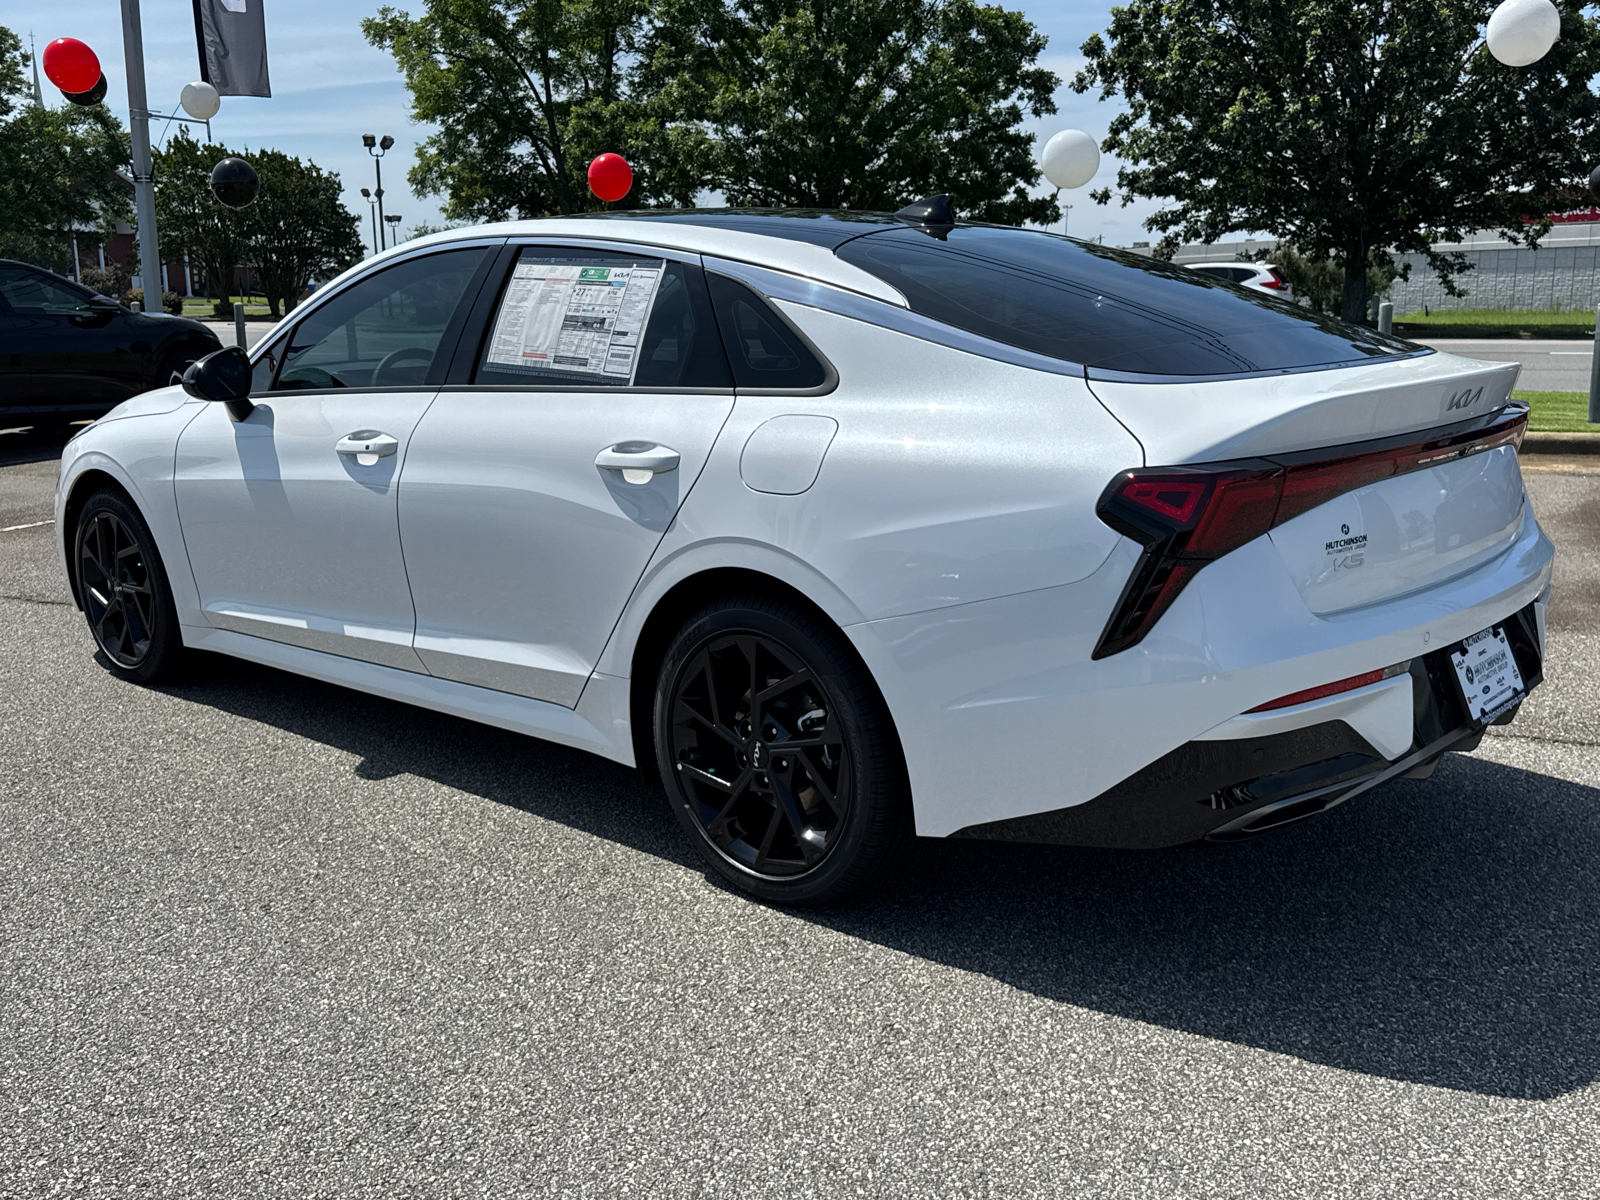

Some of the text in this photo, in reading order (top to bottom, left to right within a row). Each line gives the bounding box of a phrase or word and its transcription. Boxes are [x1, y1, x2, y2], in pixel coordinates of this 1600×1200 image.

[1446, 385, 1484, 411] KIA
[1325, 534, 1368, 550] HUTCHINSON
[1327, 545, 1353, 556] AUTOMOTIVE
[1333, 553, 1364, 572] K5
